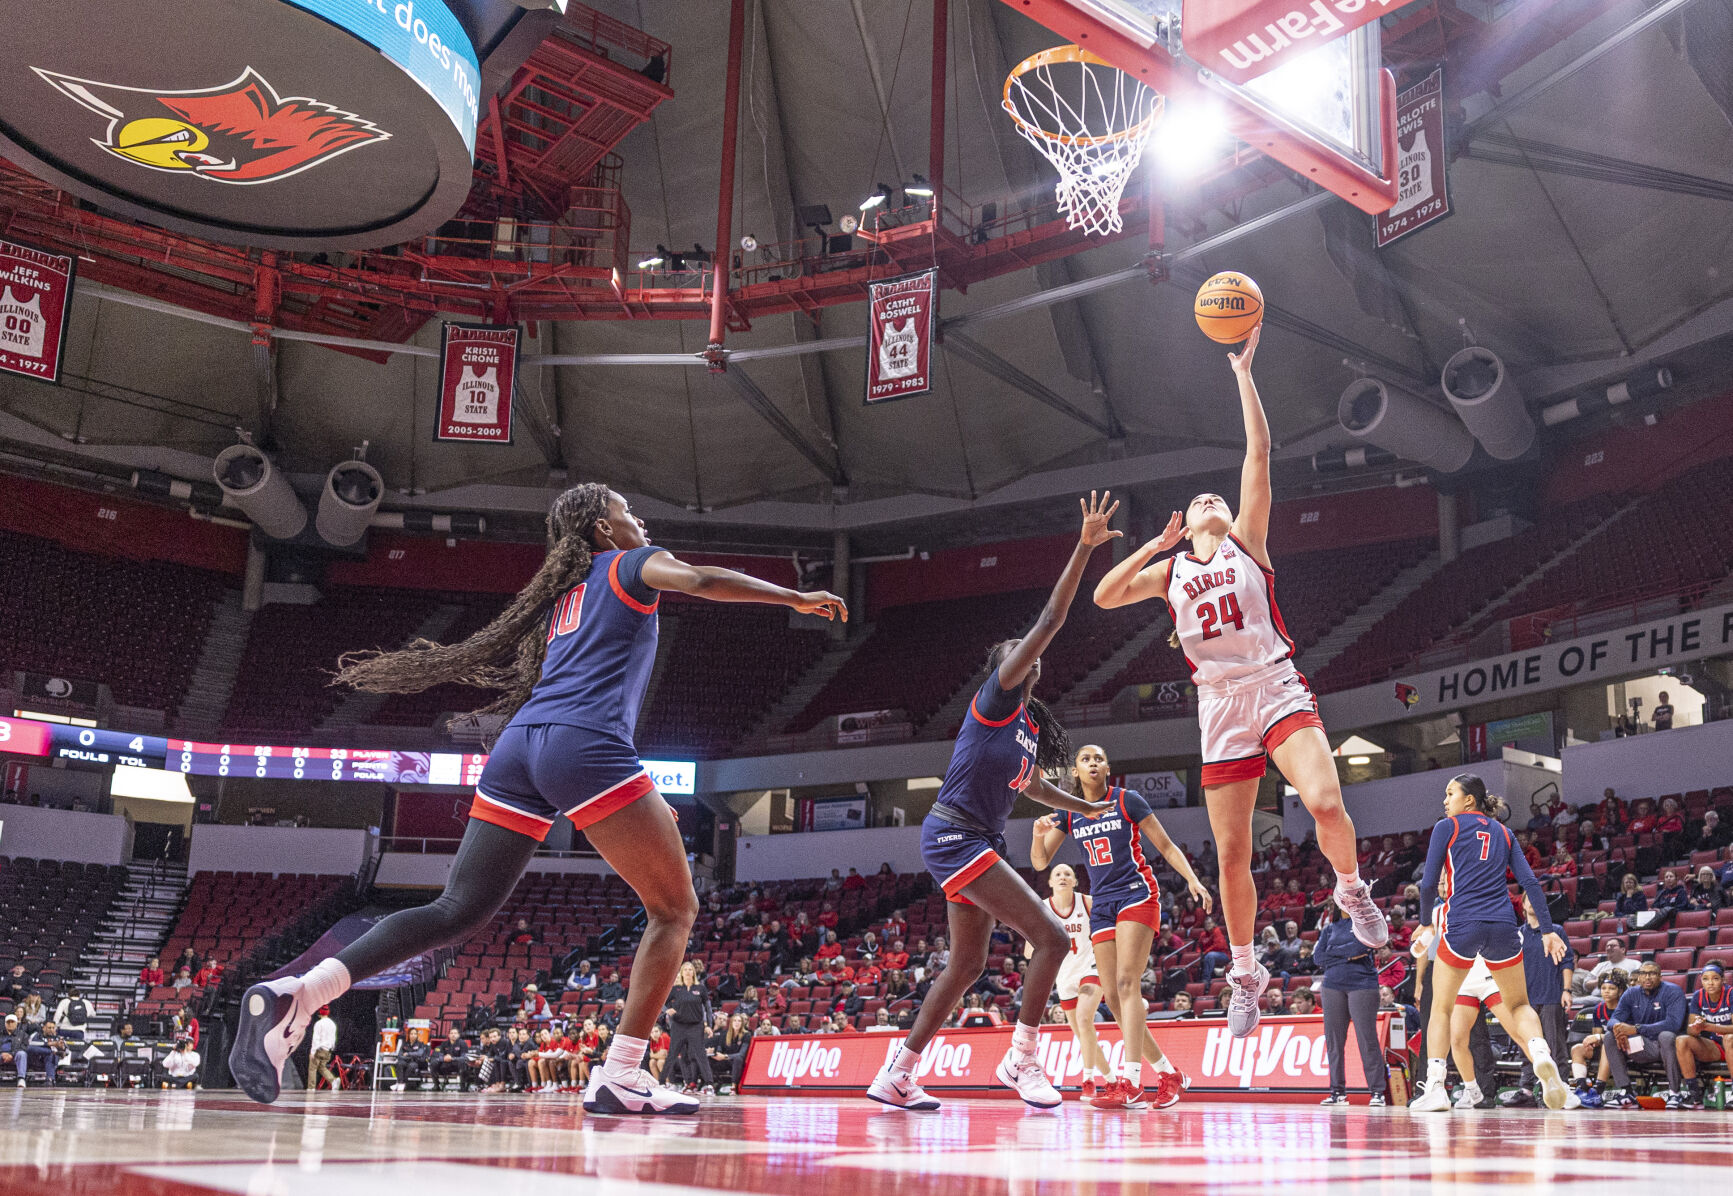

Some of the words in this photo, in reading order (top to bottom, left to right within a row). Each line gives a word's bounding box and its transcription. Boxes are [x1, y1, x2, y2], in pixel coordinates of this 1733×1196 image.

[394, 0, 451, 70] does
[1400, 164, 1421, 187] 30
[1399, 181, 1422, 201] STATE
[1382, 216, 1408, 238] 1974
[1416, 199, 1442, 219] 1978
[0, 270, 51, 291] WILKINS
[12, 265, 39, 278] JEFF
[880, 305, 921, 320] BOSWELL
[886, 297, 916, 310] CATHY
[1200, 296, 1246, 311] Wilson
[5, 315, 31, 334] 00
[2, 331, 30, 346] STATE
[449, 326, 516, 346] REDBIRDS
[885, 334, 914, 348] ILLINOIS
[461, 354, 500, 363] CIRONE
[465, 346, 497, 356] KRISTI
[889, 344, 908, 359] 44
[19, 359, 48, 373] 1977
[888, 359, 909, 369] STATE
[462, 381, 494, 392] ILLINOIS
[872, 382, 893, 394] 1979
[901, 377, 924, 389] 1983
[469, 390, 486, 404] 10
[464, 405, 488, 414] STATE
[447, 425, 502, 436] 2005-2009
[97, 508, 117, 520] 216
[1183, 568, 1236, 600] BIRDS
[547, 583, 587, 645] 10
[1196, 592, 1244, 641] 24
[1439, 655, 1541, 703] HOME
[1558, 640, 1609, 677] OF
[1625, 619, 1701, 663] THE
[79, 729, 95, 746] 0
[129, 737, 144, 752] 4
[59, 749, 109, 763] FOULS
[118, 756, 147, 767] TOL
[182, 741, 193, 752] 3
[220, 744, 231, 755] 4
[292, 747, 310, 758] 24
[329, 749, 348, 759] 33
[352, 751, 390, 760] PLAYER
[472, 754, 482, 764] 0
[181, 751, 192, 763] 0
[219, 755, 230, 766] 0
[257, 756, 267, 767] 3
[294, 757, 305, 768] 0
[332, 759, 343, 770] 0
[352, 762, 388, 770] POINTS
[180, 762, 191, 773] 0
[218, 765, 229, 776] 0
[256, 766, 266, 777] 0
[293, 768, 304, 779] 0
[331, 769, 342, 780] 0
[650, 771, 689, 787] ket.
[1144, 776, 1172, 791] OSF
[1072, 818, 1122, 840] DAYTON
[937, 834, 963, 844] FLYERS
[1476, 830, 1491, 861] 7
[1083, 836, 1114, 867] 12
[768, 1041, 842, 1086] HyVee
[884, 1036, 972, 1084] HVee
[1201, 1026, 1331, 1088] HyVee
